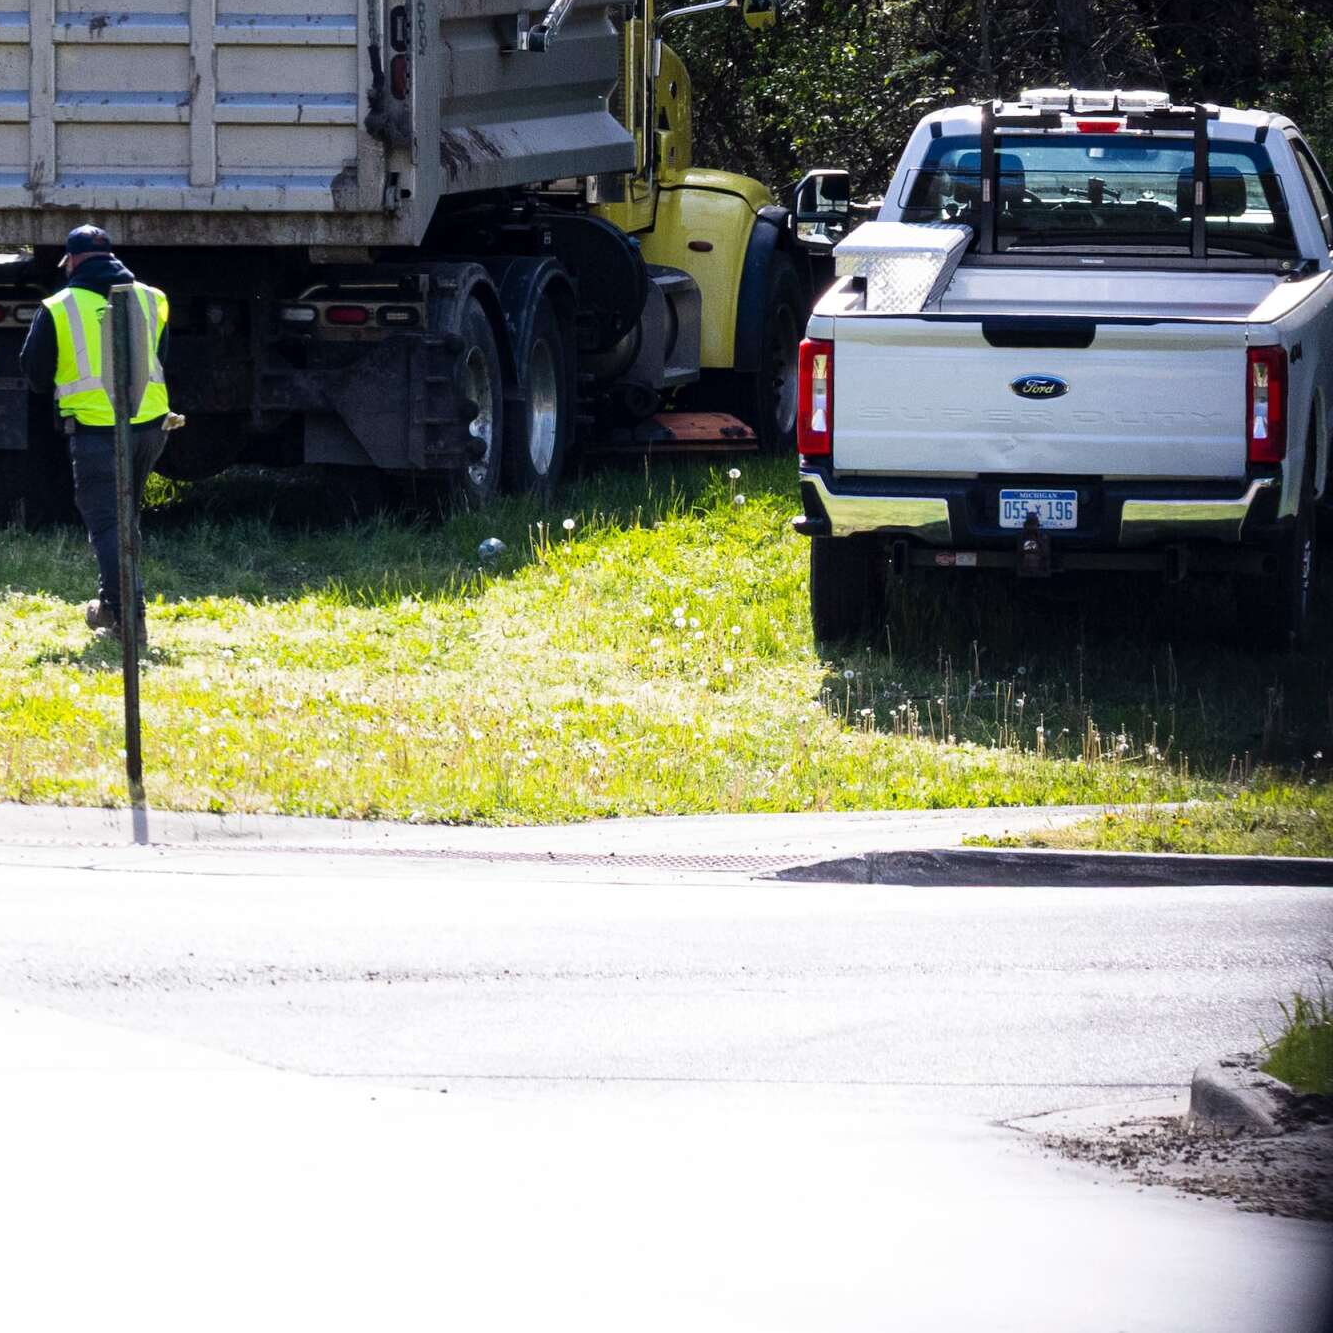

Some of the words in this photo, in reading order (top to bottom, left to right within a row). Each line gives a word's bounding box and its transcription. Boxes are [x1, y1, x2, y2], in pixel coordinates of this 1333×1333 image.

[1022, 380, 1054, 394] Ford
[858, 407, 1053, 426] SUPER
[1071, 410, 1222, 427] DUTY
[1004, 500, 1029, 520] 055
[1047, 501, 1073, 520] 196
